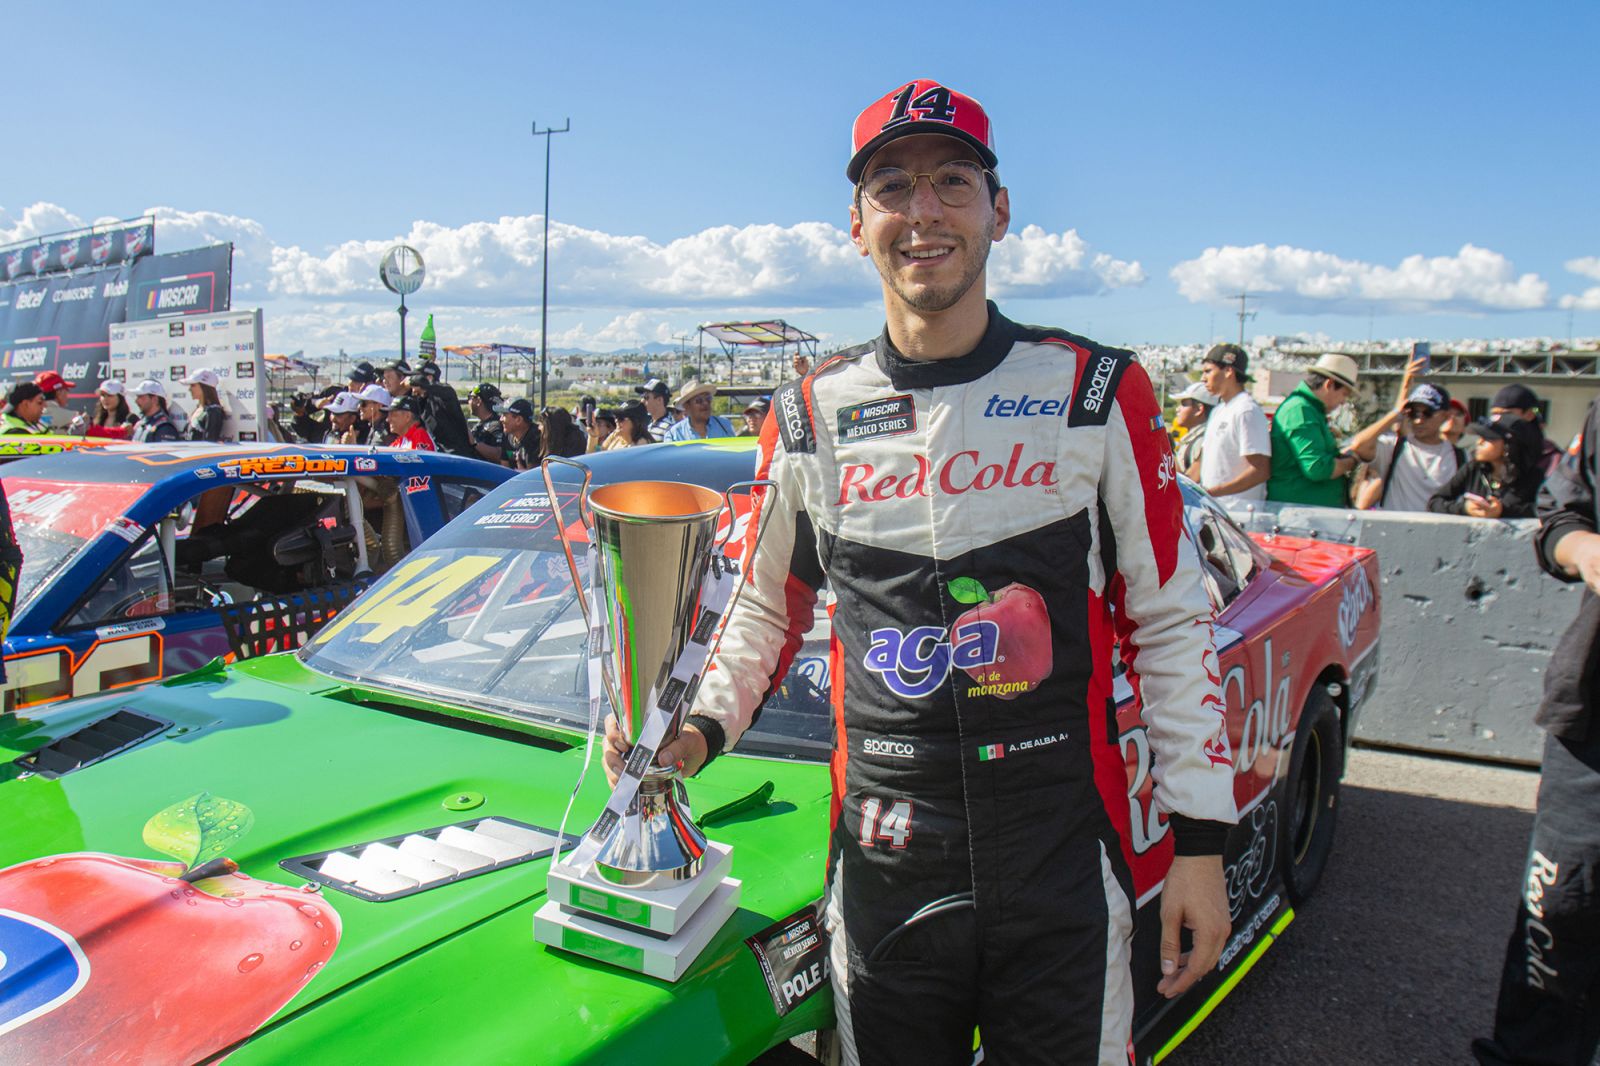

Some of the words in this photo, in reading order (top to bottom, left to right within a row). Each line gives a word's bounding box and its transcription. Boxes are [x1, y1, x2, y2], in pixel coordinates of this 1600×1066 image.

[881, 82, 956, 132] 14
[16, 288, 47, 310] telcel
[157, 285, 199, 309] NASCAR
[12, 346, 47, 368] NASCAR
[62, 362, 90, 380] telcel
[1083, 356, 1118, 413] sparco
[780, 388, 806, 441] sparco
[862, 402, 901, 419] NASCAR
[983, 394, 1072, 418] telcel
[846, 420, 880, 439] MÉXICO
[880, 416, 908, 434] SERIES
[834, 454, 934, 506] Red
[939, 442, 1059, 496] Cola
[510, 497, 558, 508] NASCA
[506, 513, 544, 524] SERIES
[314, 555, 502, 644] 14
[864, 620, 1000, 698] aga
[978, 671, 986, 682] el
[988, 670, 1000, 682] de
[968, 679, 1029, 698] manzana
[1221, 636, 1291, 774] Cola
[864, 738, 915, 758] sparco
[1008, 744, 1020, 752] A.
[1020, 740, 1033, 750] DE
[1034, 736, 1058, 747] ALBA
[859, 797, 913, 849] 14
[788, 922, 810, 940] NASCAR
[782, 941, 802, 960] MÉXICO
[802, 934, 818, 950] SERIES
[1526, 918, 1559, 990] Cola
[782, 962, 822, 1005] POLE
